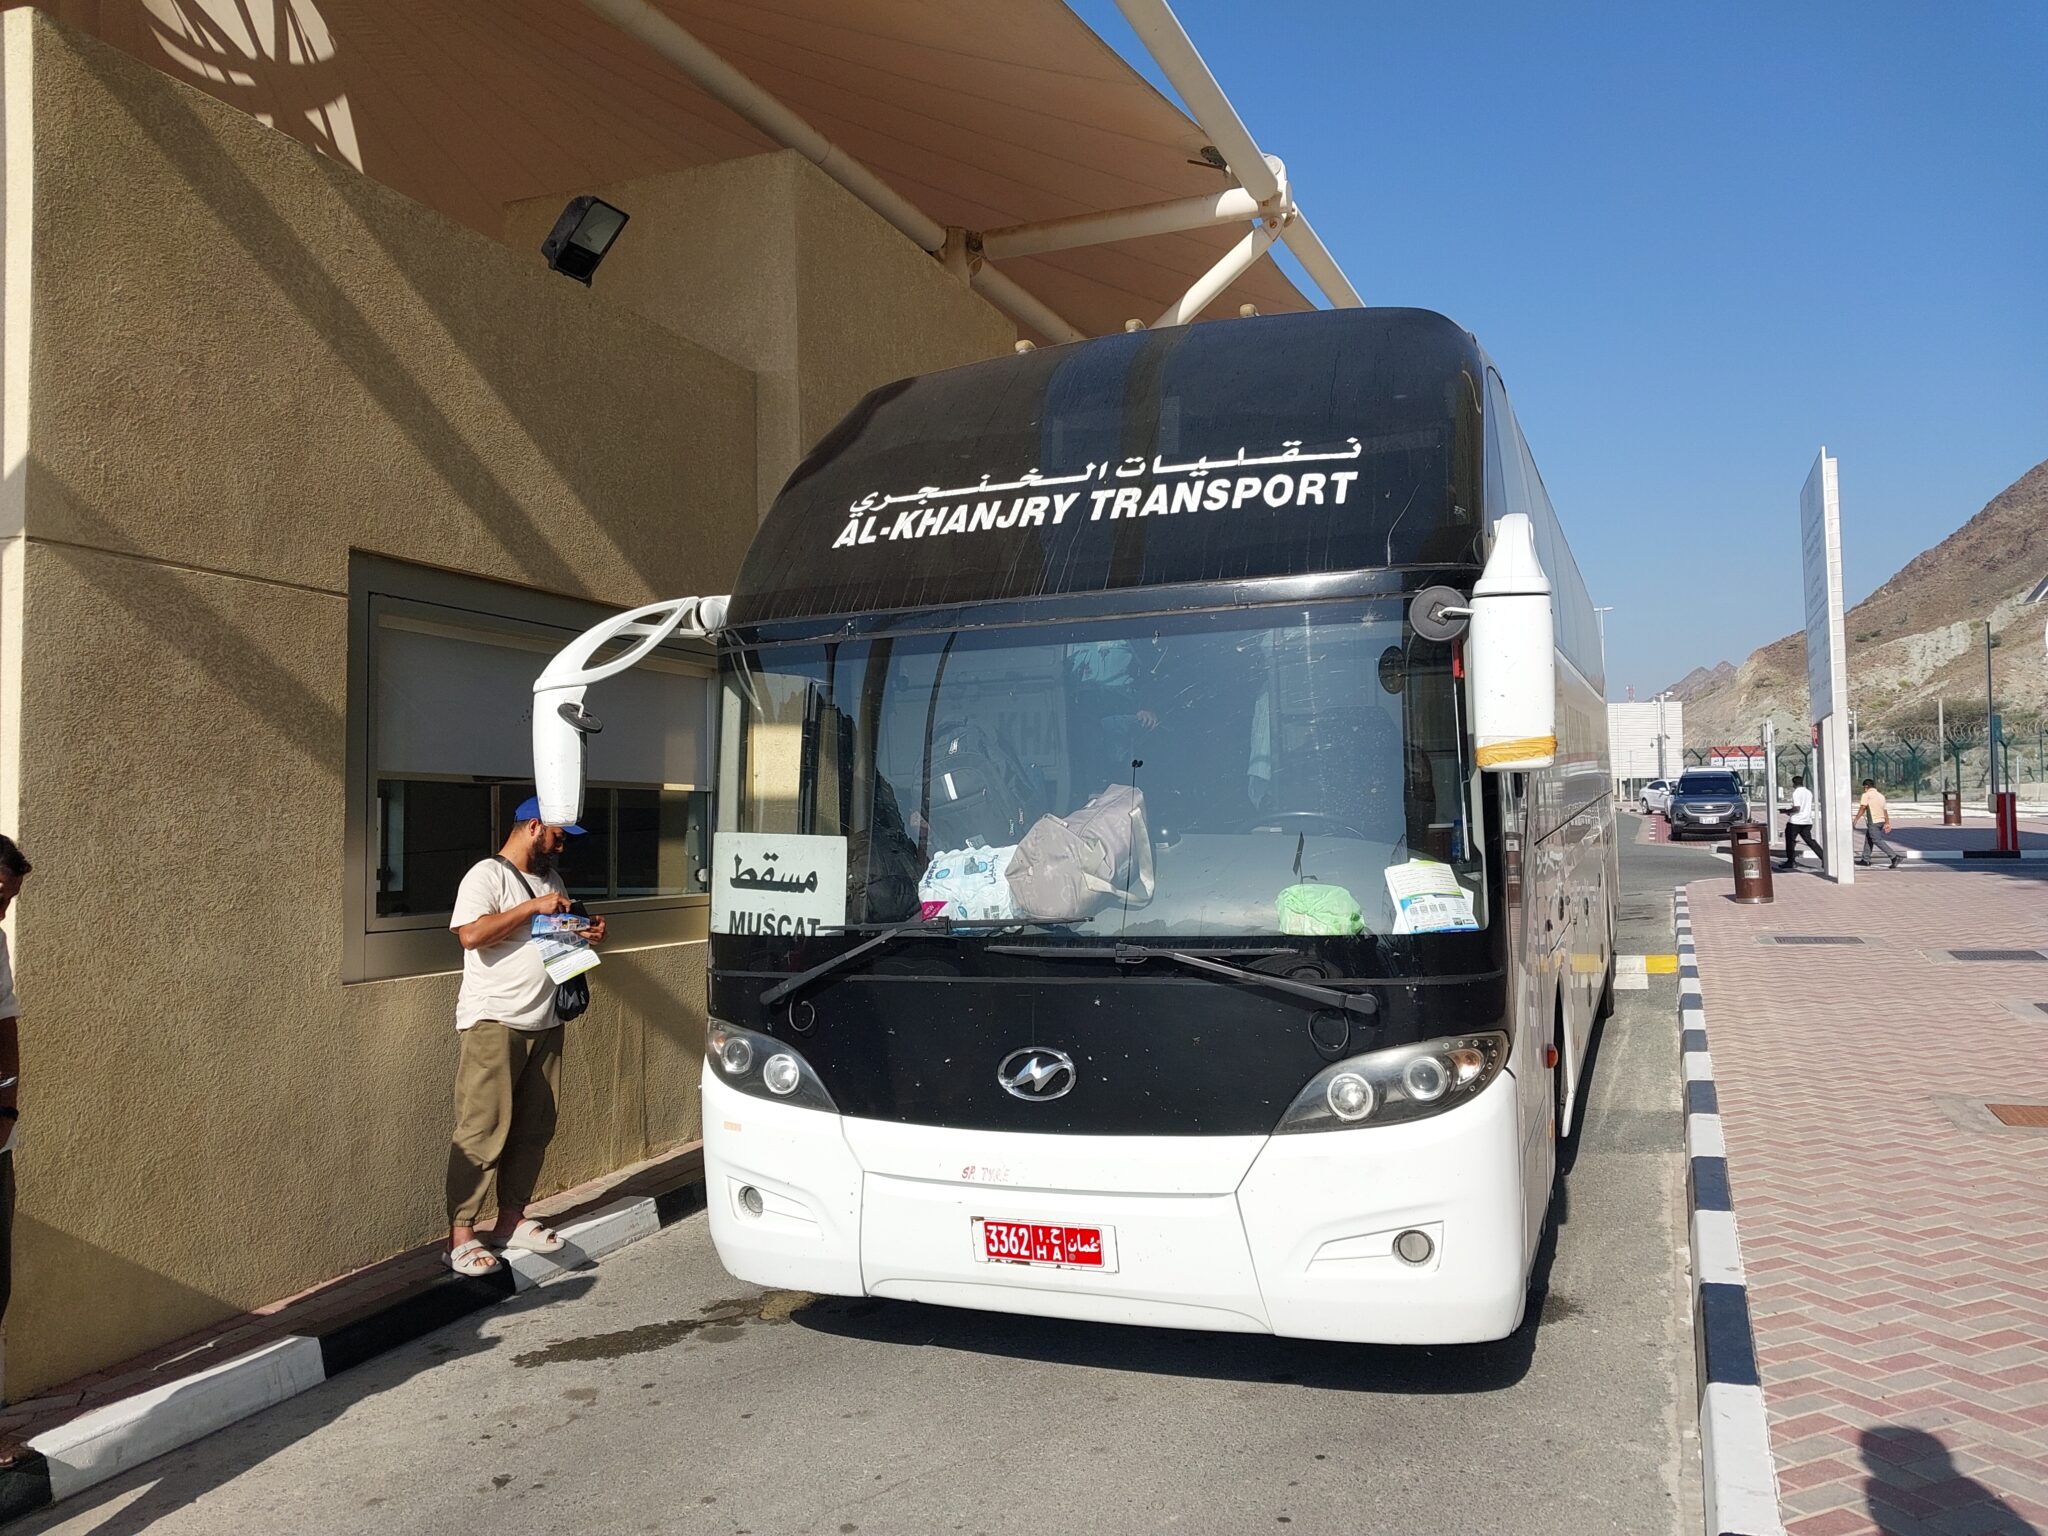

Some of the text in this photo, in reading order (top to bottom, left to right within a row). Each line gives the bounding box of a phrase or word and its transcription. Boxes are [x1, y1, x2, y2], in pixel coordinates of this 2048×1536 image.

[849, 437, 1362, 517] نقليات الخنجري
[832, 471, 1359, 549] AL-KHANJRY TRANSPORT
[729, 852, 819, 894] مسقط
[728, 910, 821, 937] MUSCAT
[986, 1224, 1031, 1256] 3362
